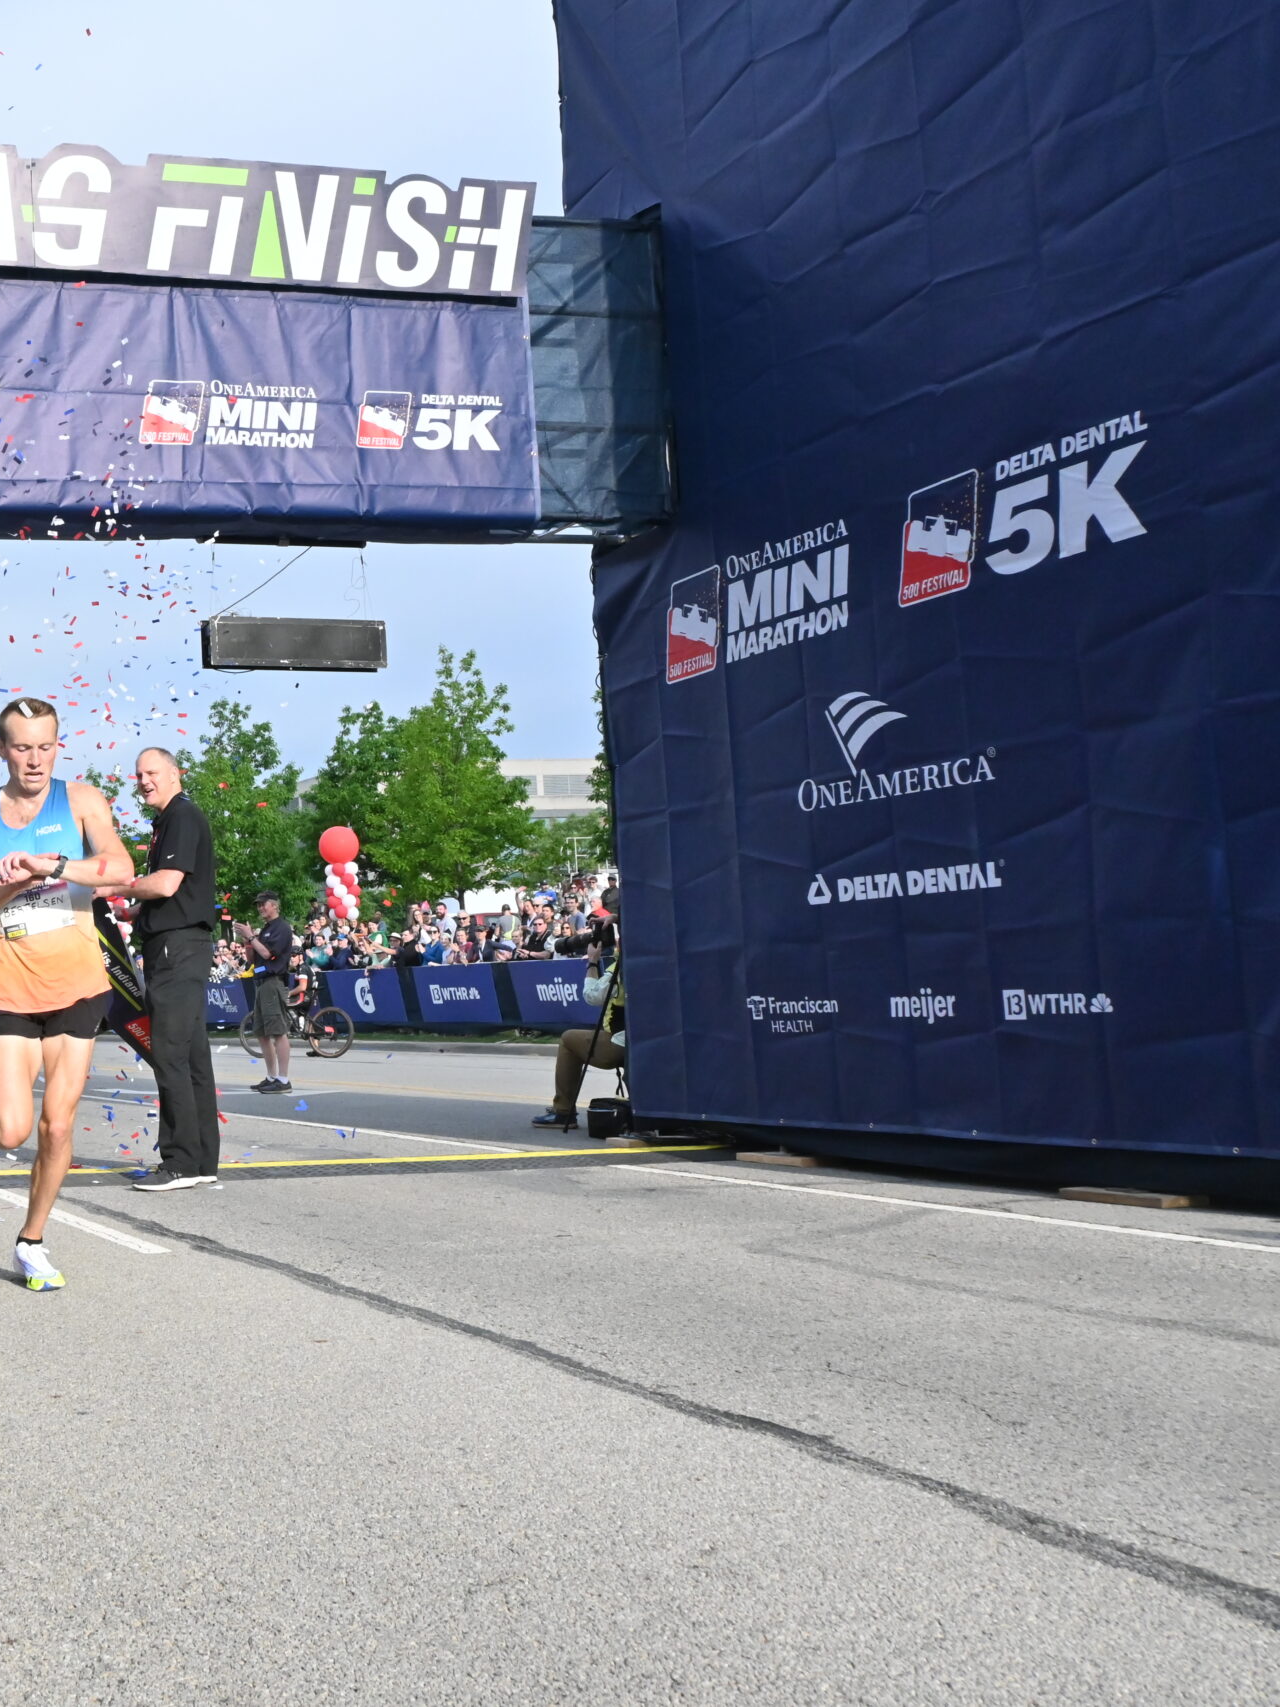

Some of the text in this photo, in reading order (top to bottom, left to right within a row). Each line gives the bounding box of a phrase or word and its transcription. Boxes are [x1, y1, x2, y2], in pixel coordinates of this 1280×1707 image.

[146, 162, 528, 292] FINISH
[207, 395, 318, 431] MINI
[421, 394, 503, 407] DELTA DENTAL
[158, 431, 190, 442] FESTIVAL
[205, 427, 315, 449] MARATHON
[371, 436, 401, 447] FESTIVAL
[412, 407, 502, 451] 5K
[995, 410, 1148, 482] DELTA DENTAL
[984, 440, 1148, 576] 5K
[727, 543, 850, 634] MINI
[902, 567, 965, 602] 500 FESTIVAL
[725, 600, 849, 664] MARATHON
[669, 651, 713, 680] 500 FESTIVAL
[837, 861, 1002, 903] DELTA DENTAL
[110, 965, 141, 998] Indiana
[441, 986, 469, 1001] WTHR
[536, 977, 579, 1007] meijer
[768, 996, 839, 1014] Franciscan
[890, 988, 956, 1024] meijer
[1028, 992, 1088, 1015] WTHR
[128, 1023, 146, 1037] 500
[771, 1019, 814, 1033] HEALTH
